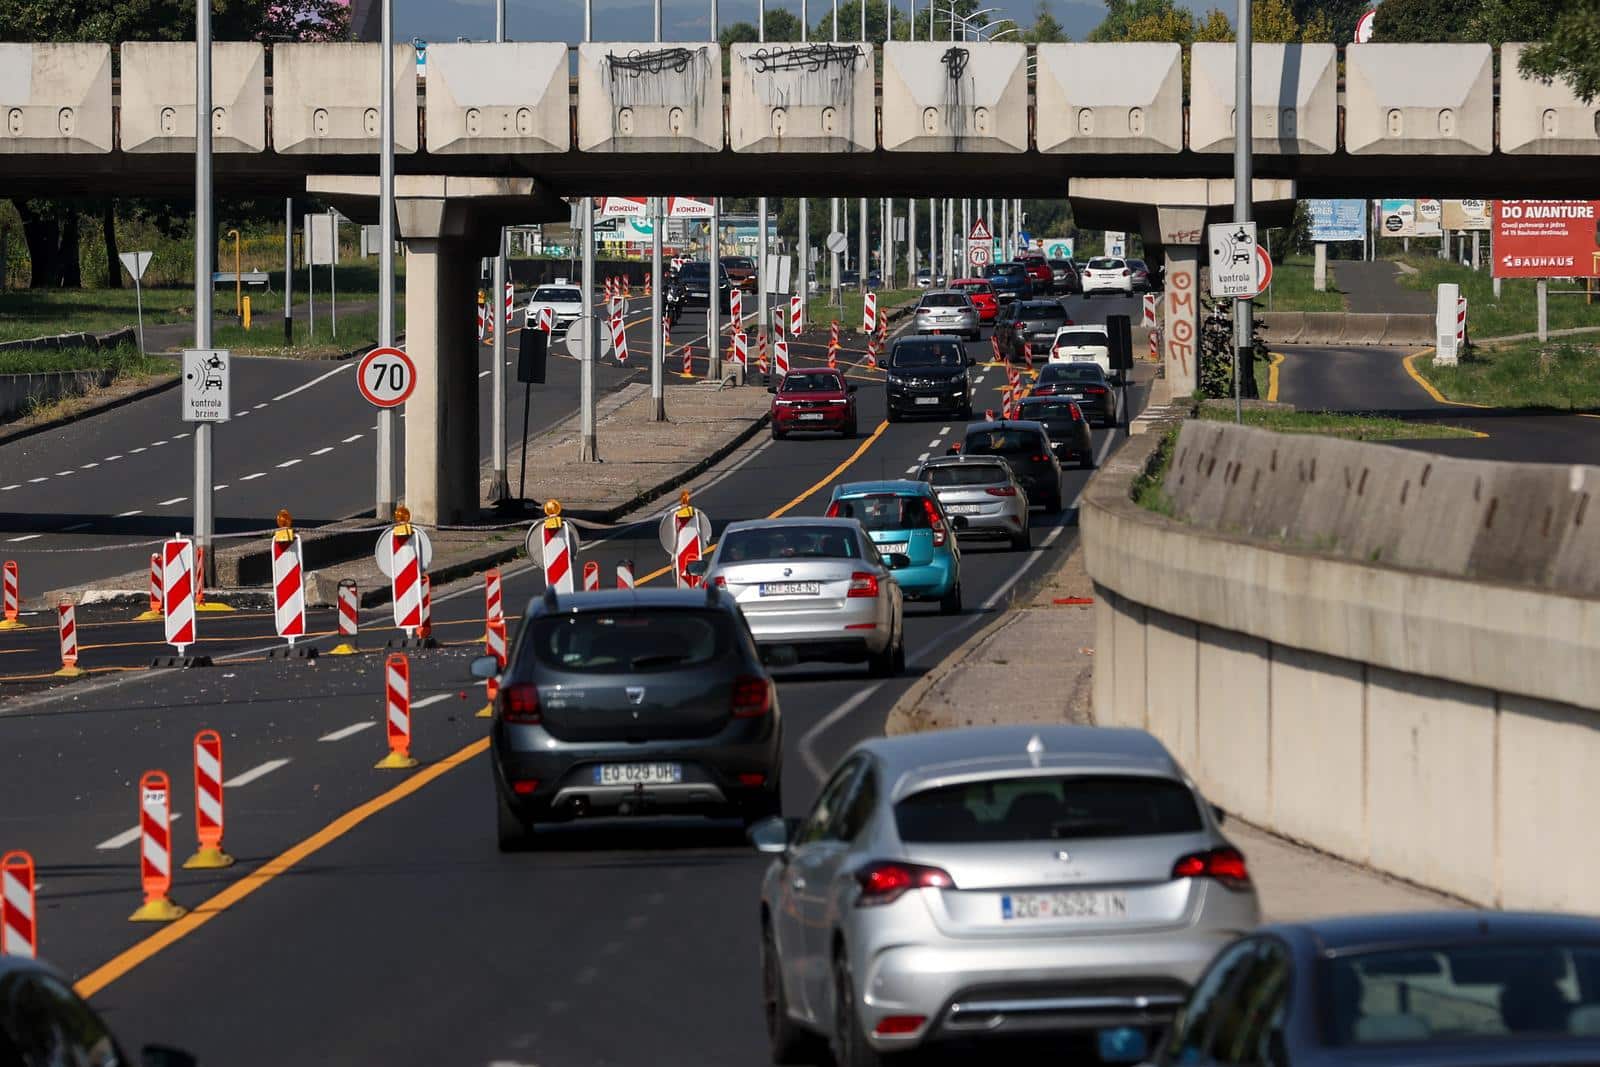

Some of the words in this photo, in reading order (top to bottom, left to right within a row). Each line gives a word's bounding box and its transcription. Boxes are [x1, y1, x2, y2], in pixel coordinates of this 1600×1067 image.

[1502, 206, 1522, 218] DO
[1525, 206, 1594, 218] AVANTURE
[974, 251, 986, 261] 70
[1514, 256, 1574, 266] BAUHAUS
[1218, 274, 1250, 283] kontrola
[1223, 286, 1248, 294] brzine
[373, 363, 404, 392] 70
[191, 398, 222, 408] kontrola
[195, 408, 219, 418] brzine
